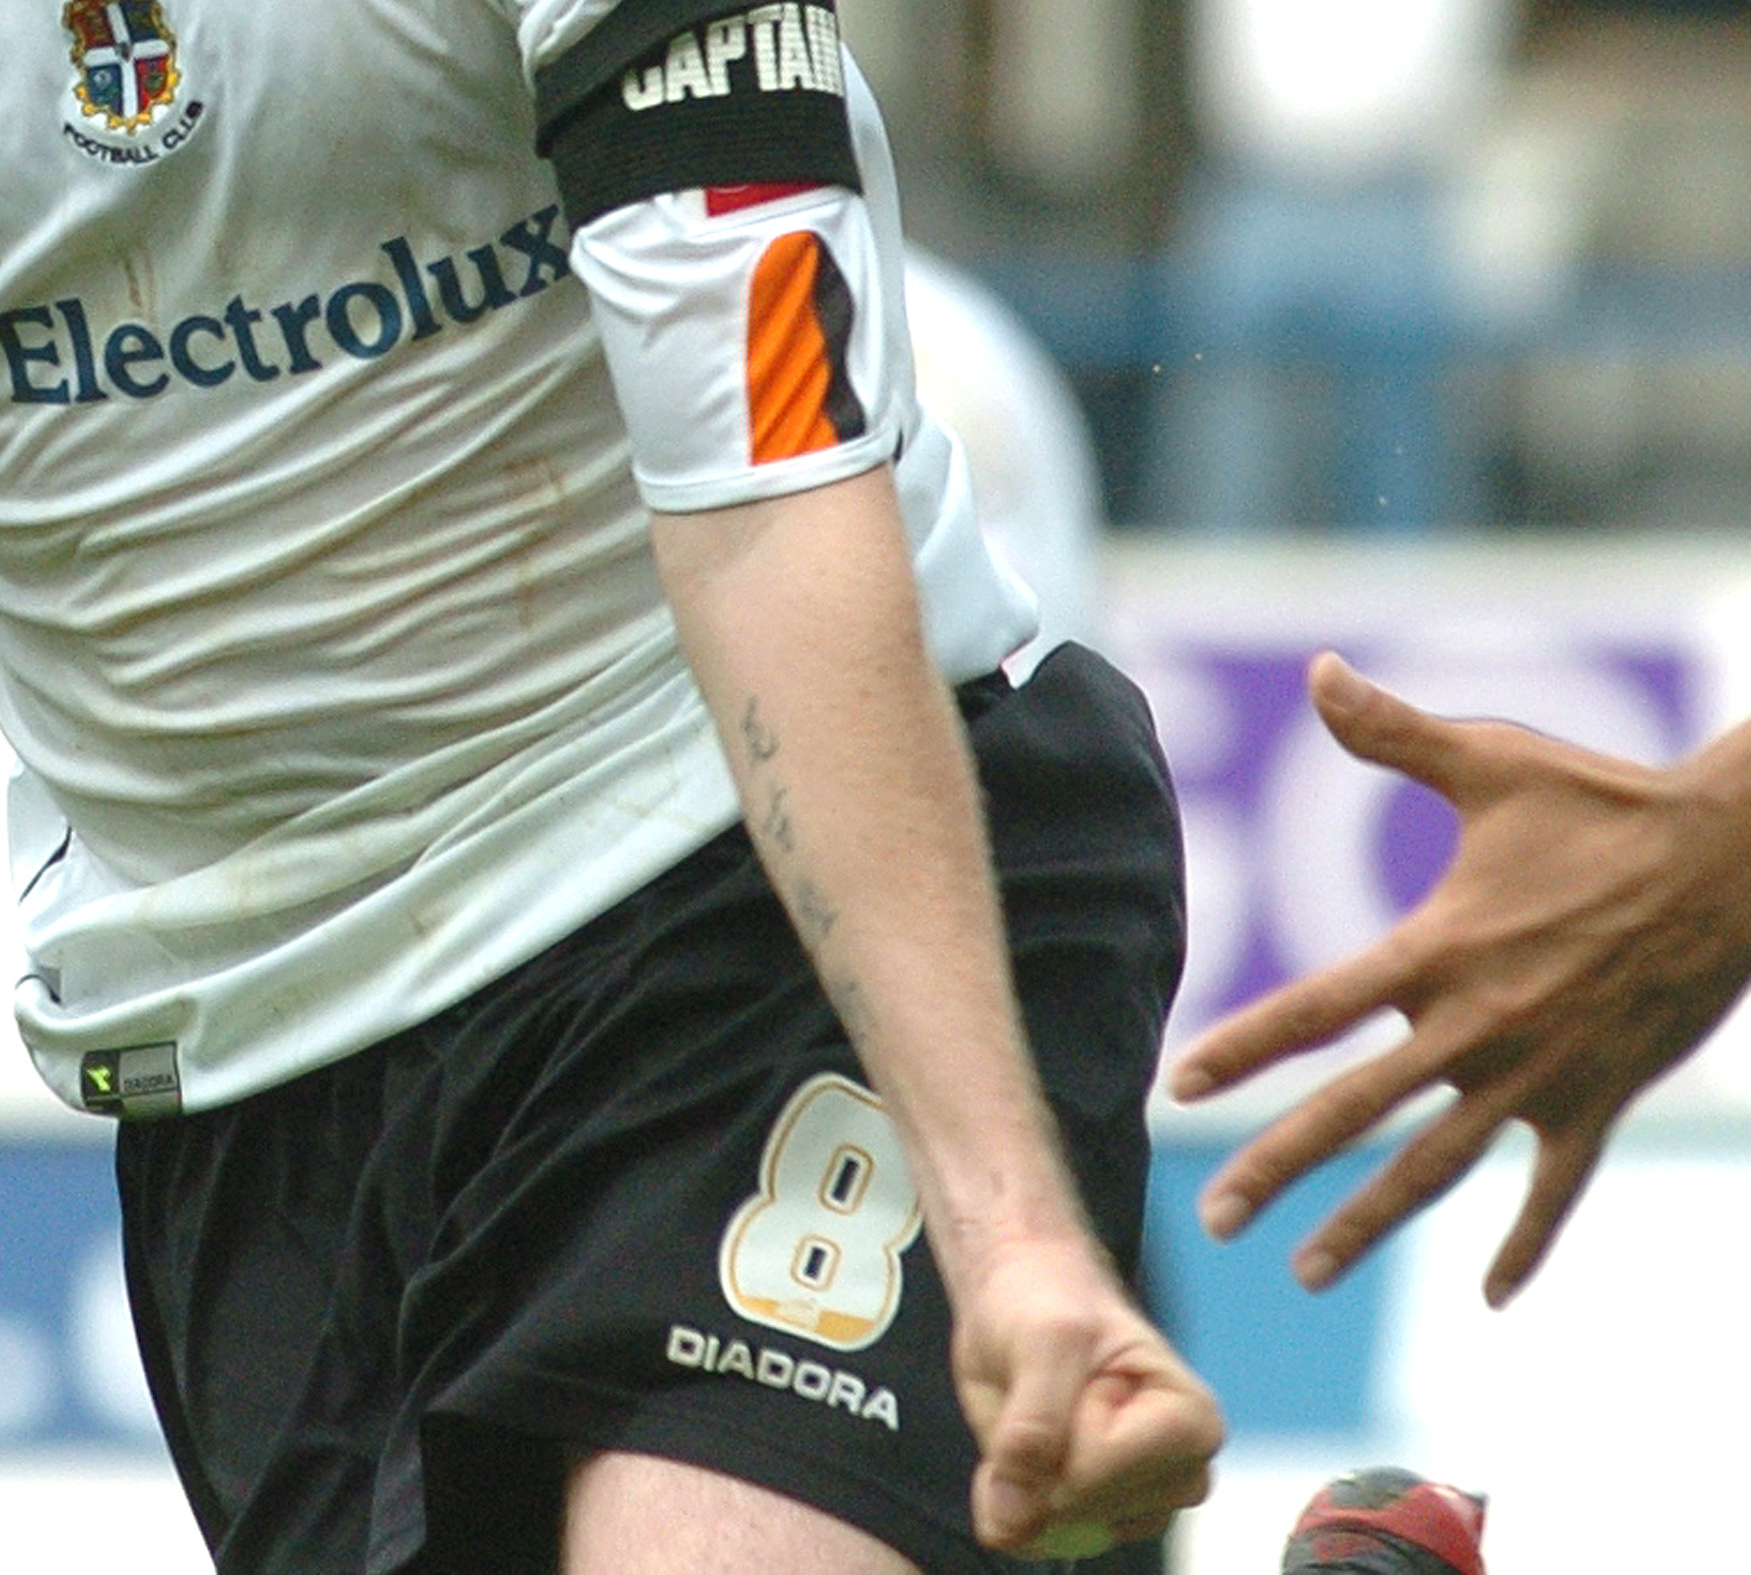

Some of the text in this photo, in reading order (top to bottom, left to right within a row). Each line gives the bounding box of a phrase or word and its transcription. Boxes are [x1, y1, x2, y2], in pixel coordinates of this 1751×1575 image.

[63, 101, 204, 164] FOOTBALL CLUB
[719, 1071, 924, 1352] 8
[666, 1325, 900, 1432] DIADORA
